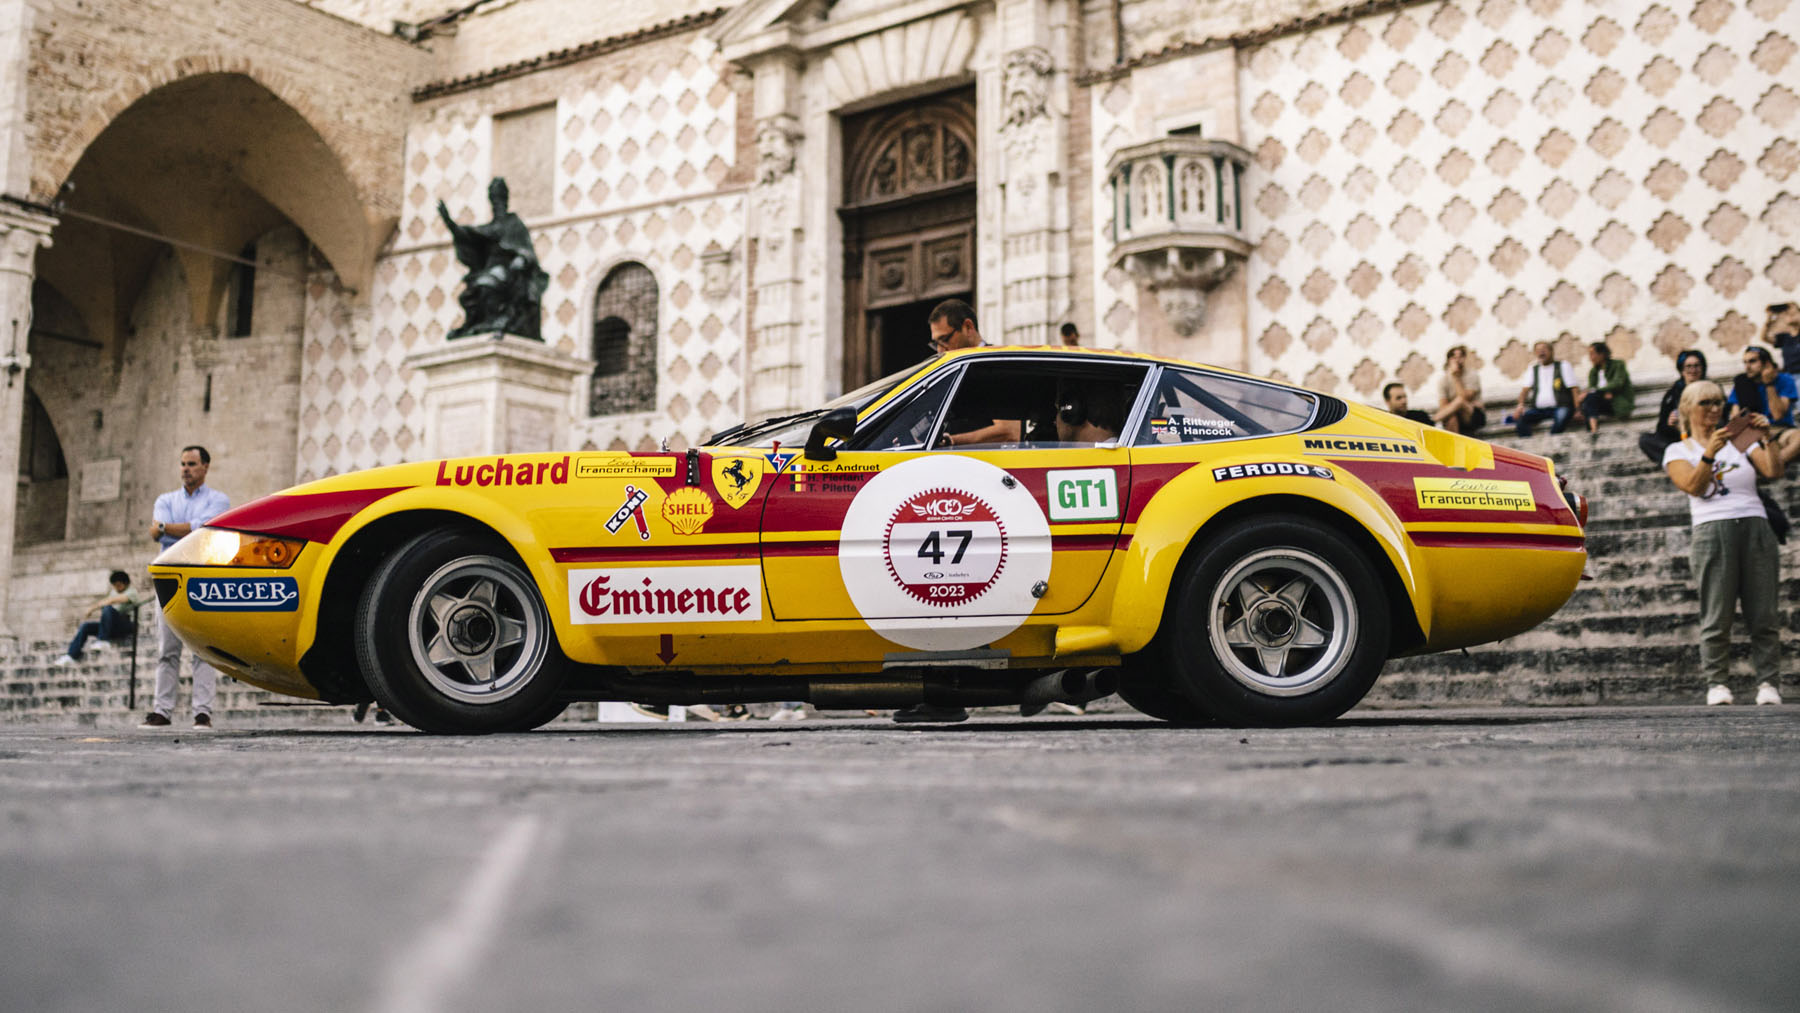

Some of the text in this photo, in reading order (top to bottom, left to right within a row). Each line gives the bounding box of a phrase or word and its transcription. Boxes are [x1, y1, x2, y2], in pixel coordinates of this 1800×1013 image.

[1168, 417, 1235, 428] A. Rittweger
[1169, 426, 1232, 436] S. Hancock
[1304, 439, 1418, 454] MICHELIN
[435, 456, 570, 487] Luchard
[580, 465, 672, 475] Francorchamps
[808, 464, 880, 472] J.-C. Andruet
[1214, 463, 1310, 481] FERODO
[1057, 479, 1107, 509] GT1
[1421, 490, 1531, 511] Francorchamps
[608, 492, 647, 532] KONI
[668, 503, 708, 516] SHELL
[917, 530, 973, 565] 47
[193, 582, 292, 601] JAEGER
[579, 575, 751, 617] Eminence
[929, 585, 966, 598] 2023
